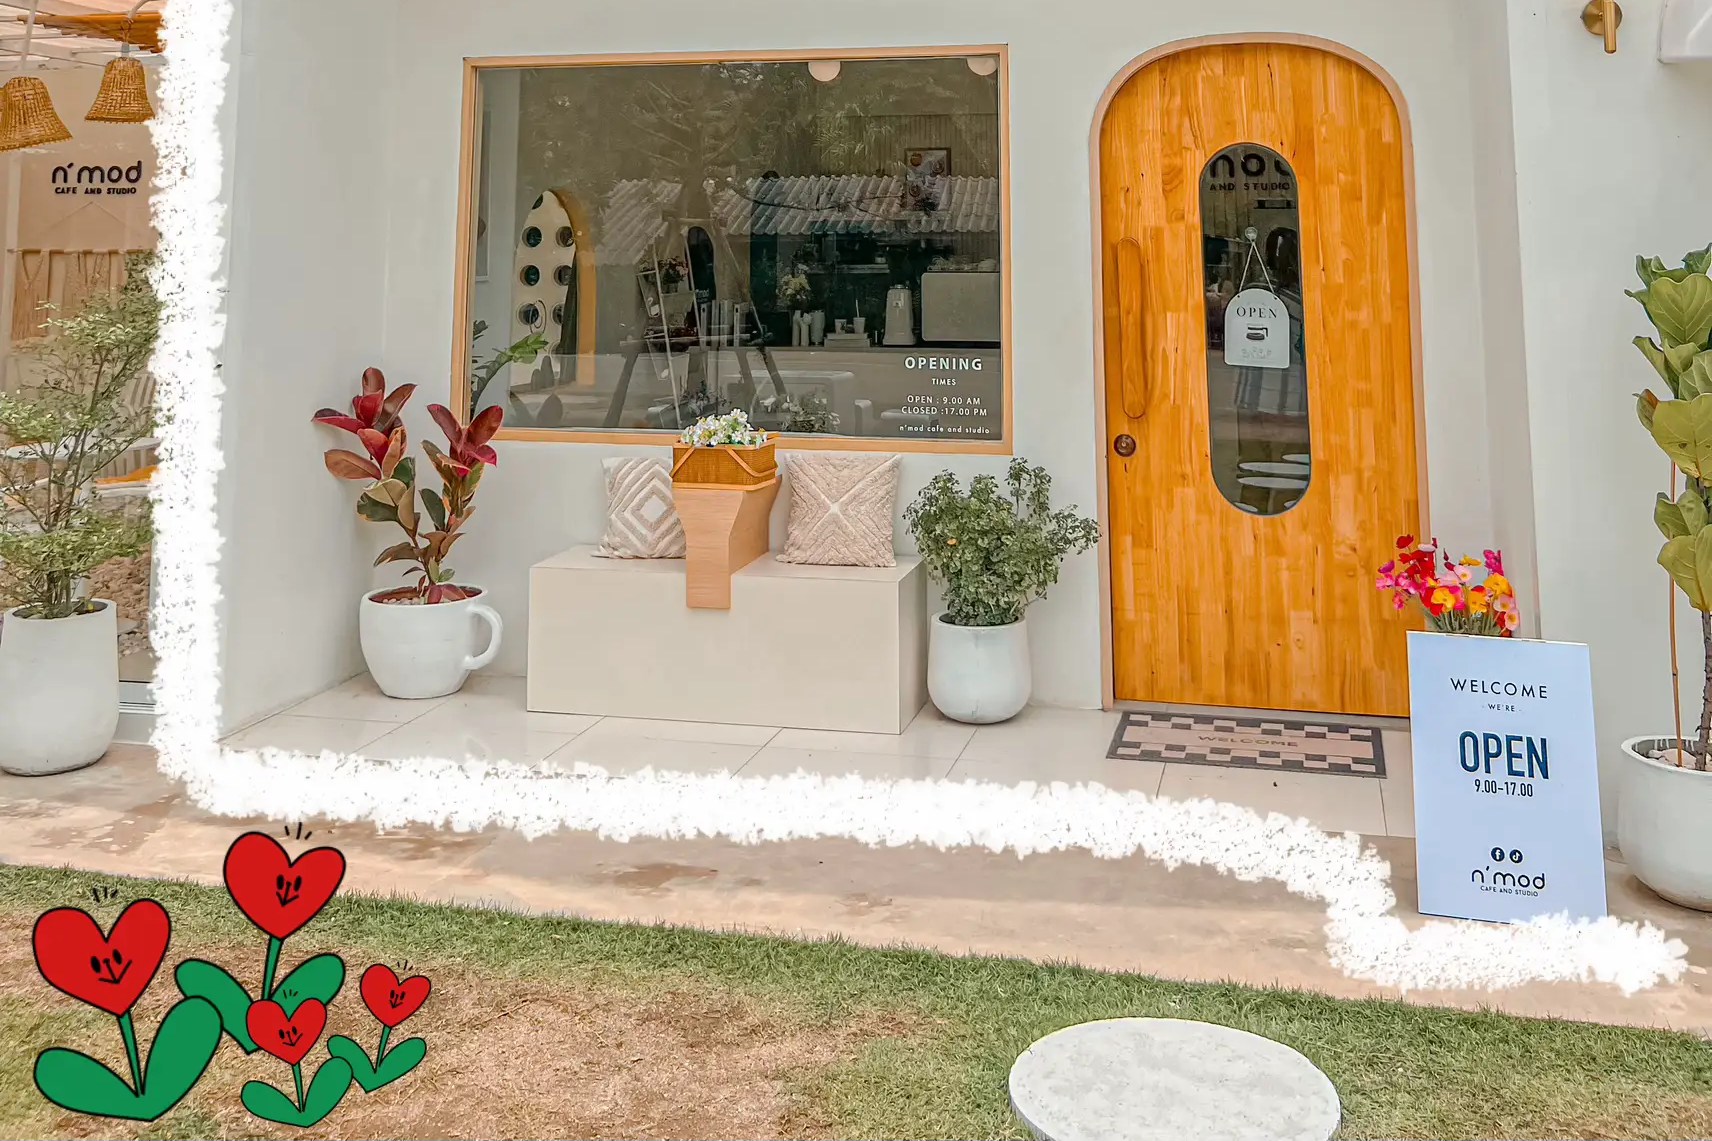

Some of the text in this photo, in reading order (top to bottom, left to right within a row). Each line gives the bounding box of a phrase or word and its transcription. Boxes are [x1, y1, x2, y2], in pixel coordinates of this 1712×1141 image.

[55, 186, 137, 195] CAFE AND STUDIO
[1210, 182, 1290, 191] AND STUDIO
[1236, 306, 1279, 319] OPEN
[904, 356, 982, 371] OPENING
[931, 378, 957, 386] TIMES
[907, 395, 933, 404] OPEN
[942, 396, 963, 405] 9.00
[966, 397, 981, 405] AM
[901, 406, 938, 415] CLOSED
[973, 408, 987, 416] PM
[927, 424, 944, 433] cafe
[947, 425, 962, 433] and
[965, 426, 990, 434] studio
[1450, 677, 1548, 699] WELCOME
[1198, 734, 1299, 748] WELCOME
[1459, 730, 1550, 780] OPEN
[1474, 778, 1533, 797] 9.00-17.00
[1480, 885, 1539, 897] CAFE AND STUDIO
